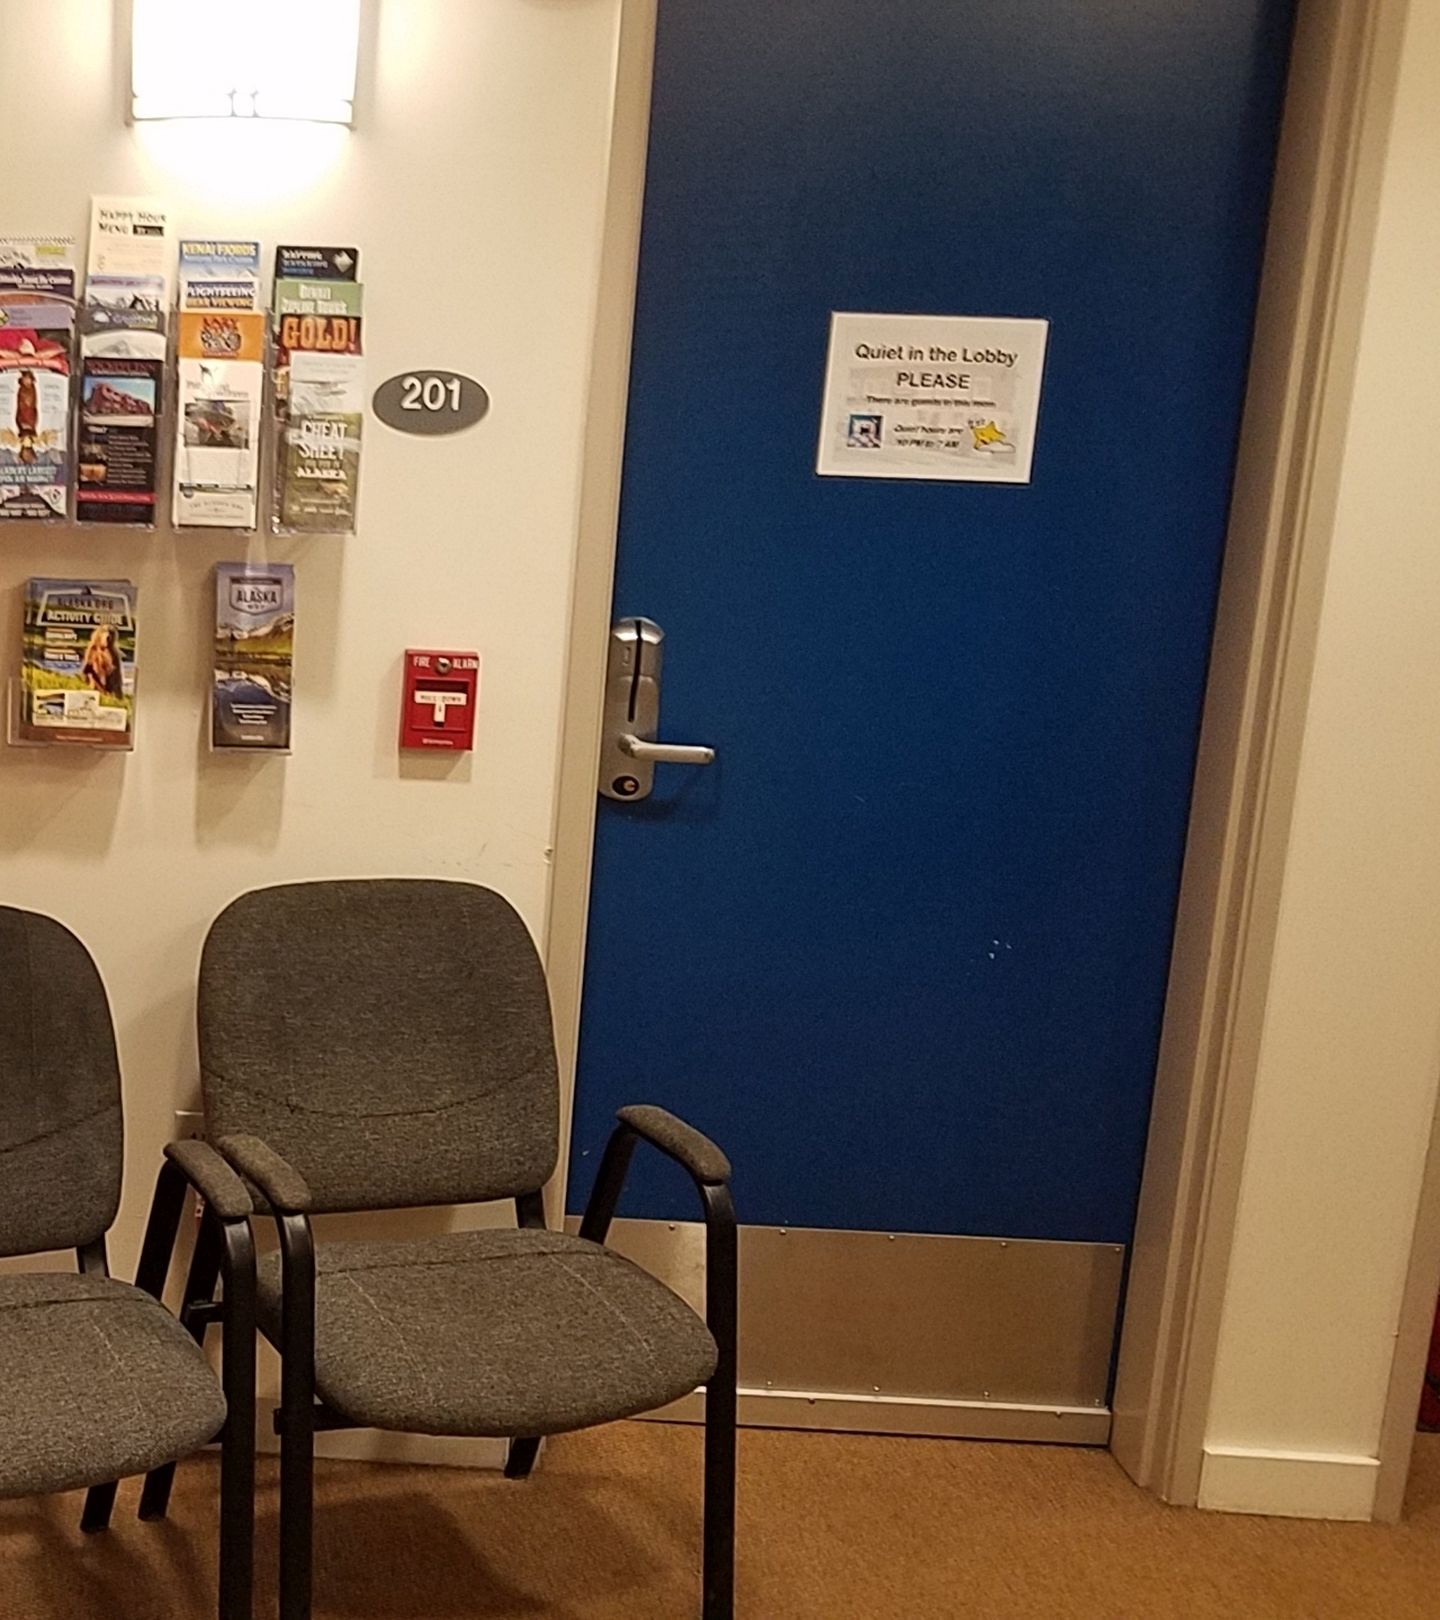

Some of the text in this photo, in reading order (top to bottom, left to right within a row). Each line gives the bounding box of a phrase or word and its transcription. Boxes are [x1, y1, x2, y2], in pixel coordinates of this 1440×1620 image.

[99, 222, 128, 234] MENU
[182, 242, 216, 255] KENAI
[282, 315, 357, 351] GOLD!
[855, 344, 1018, 367] Quiet in the Lobby
[896, 372, 971, 390] PLEASE
[401, 376, 460, 411] 201
[302, 420, 348, 441] CHEAT
[300, 442, 344, 460] SHEET
[236, 589, 278, 603] ALASKA
[47, 610, 92, 623] ACTIVITY
[413, 656, 479, 670] FIRE ALARM
